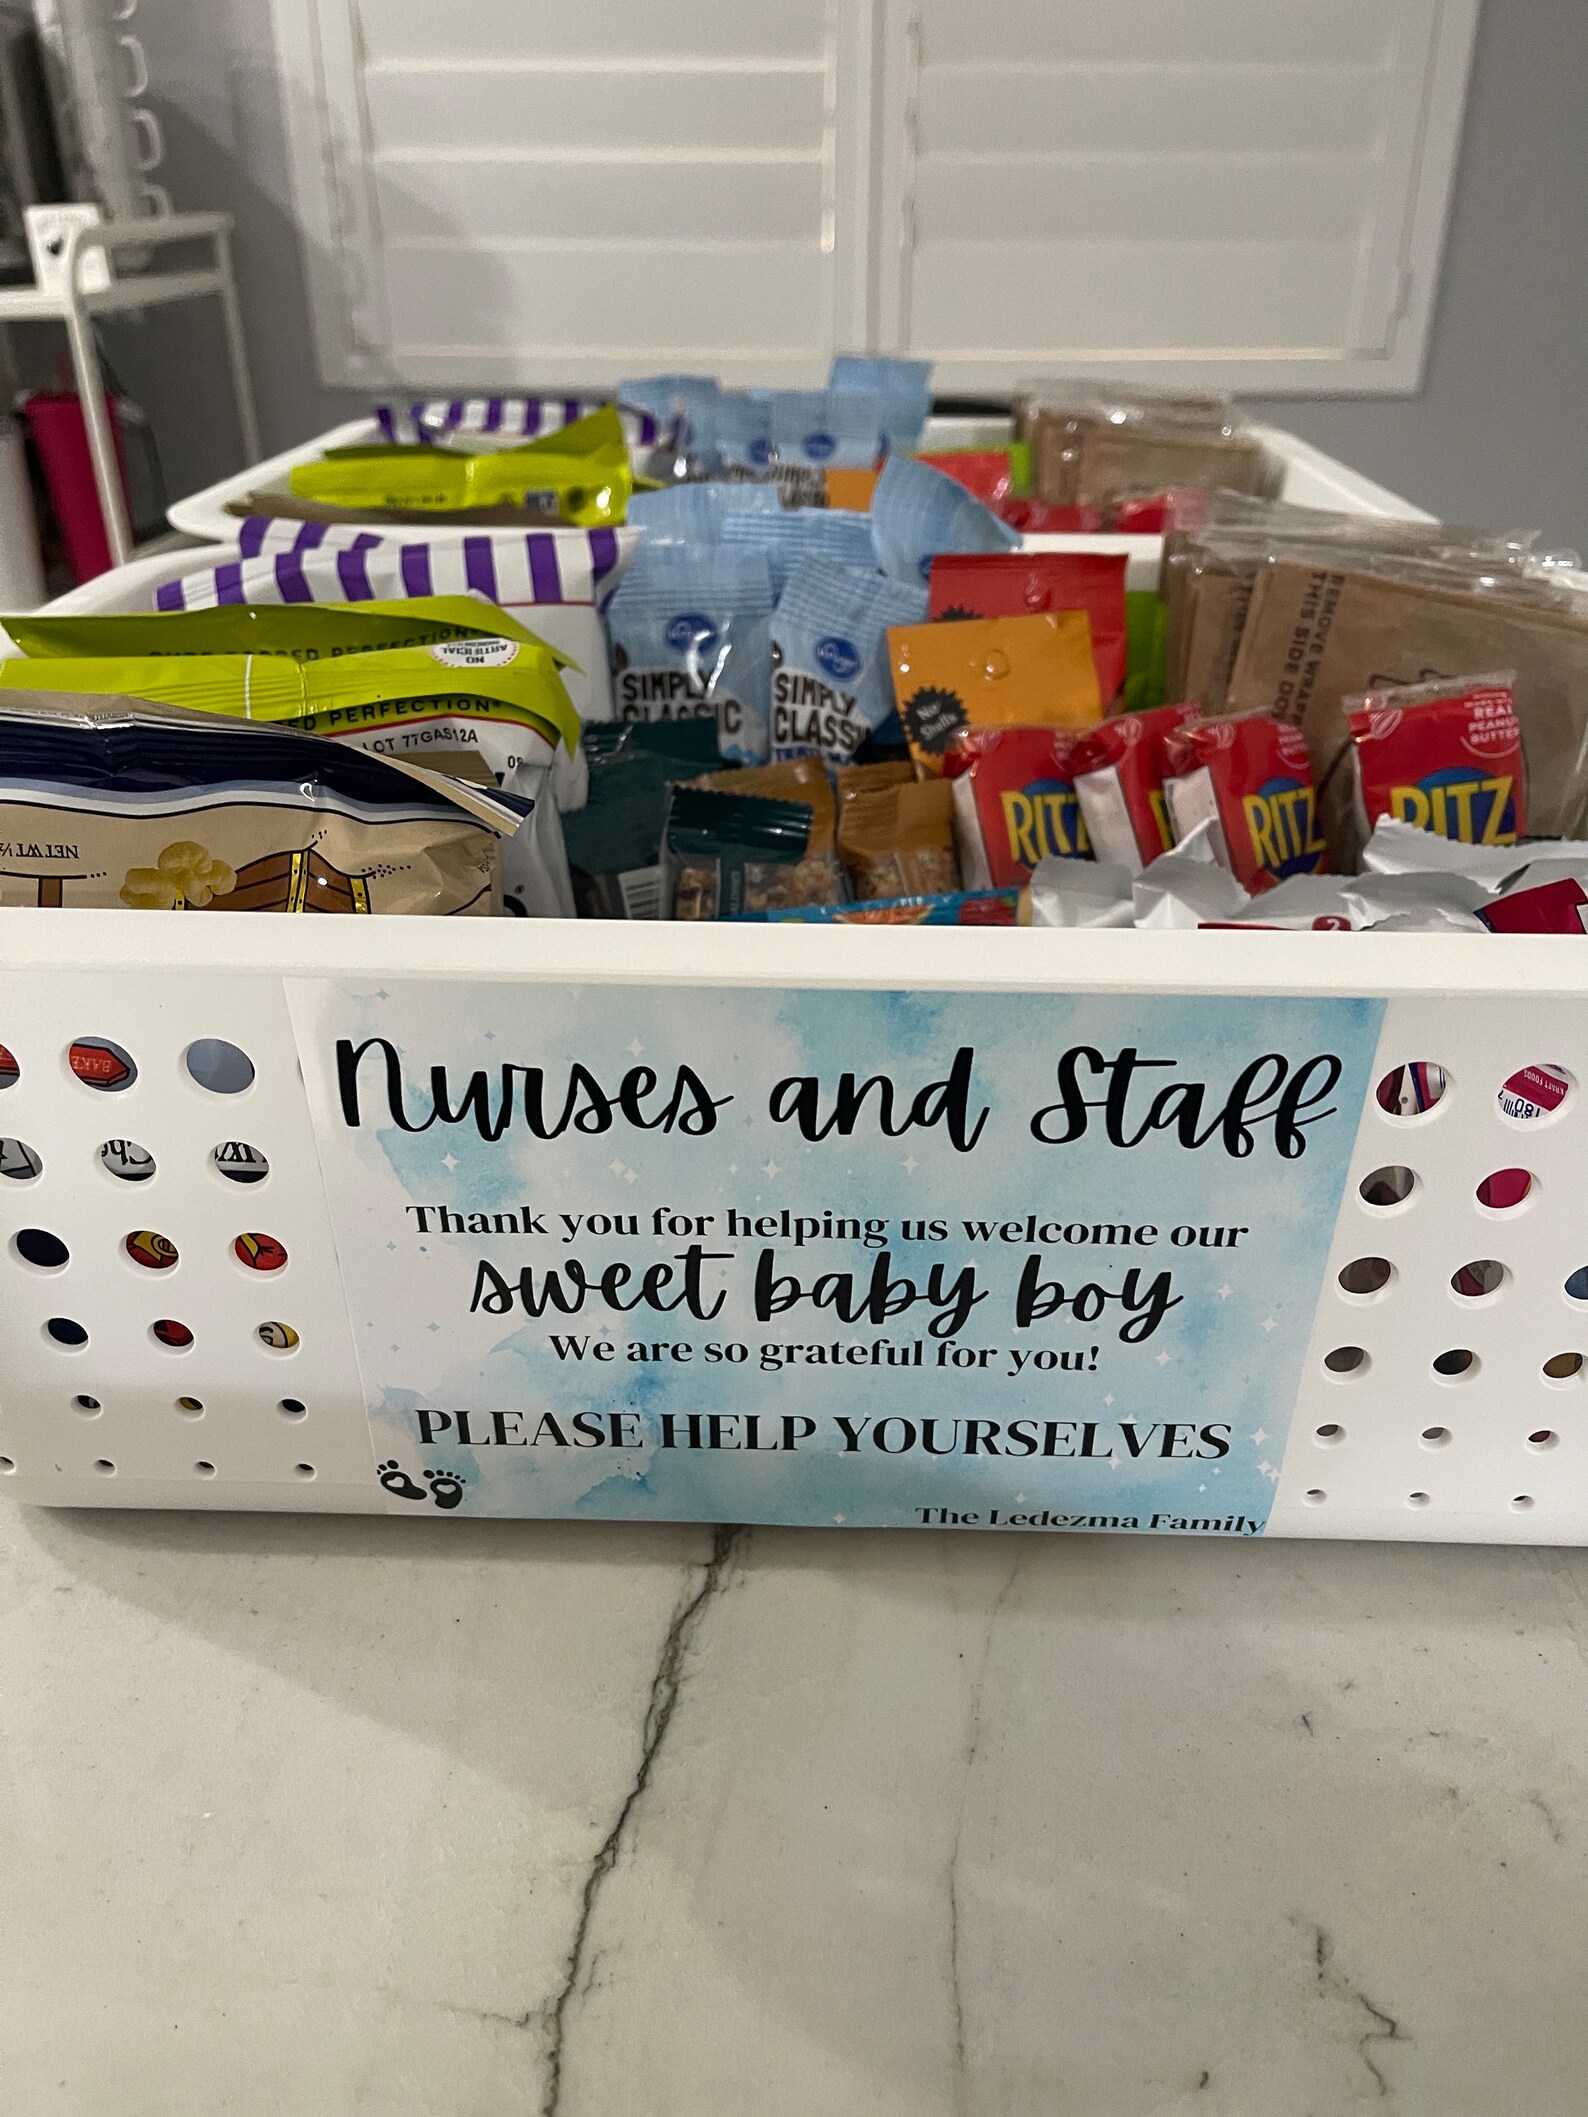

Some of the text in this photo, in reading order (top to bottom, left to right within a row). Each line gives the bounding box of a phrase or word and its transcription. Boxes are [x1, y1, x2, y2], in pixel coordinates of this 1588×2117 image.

[1241, 786, 1327, 868] RITZ
[45, 843, 80, 859] NET
[336, 1037, 1343, 1159] Nurses and Staff
[405, 1205, 1249, 1249] Thank you for helping us welcome our
[469, 1244, 1184, 1343] sweet baby boy
[548, 1335, 1099, 1377] We are so grateful for you!
[415, 1409, 1232, 1460] PLEASE HELP YOURSELVES
[914, 1507, 1267, 1537] The Ledezma Family
